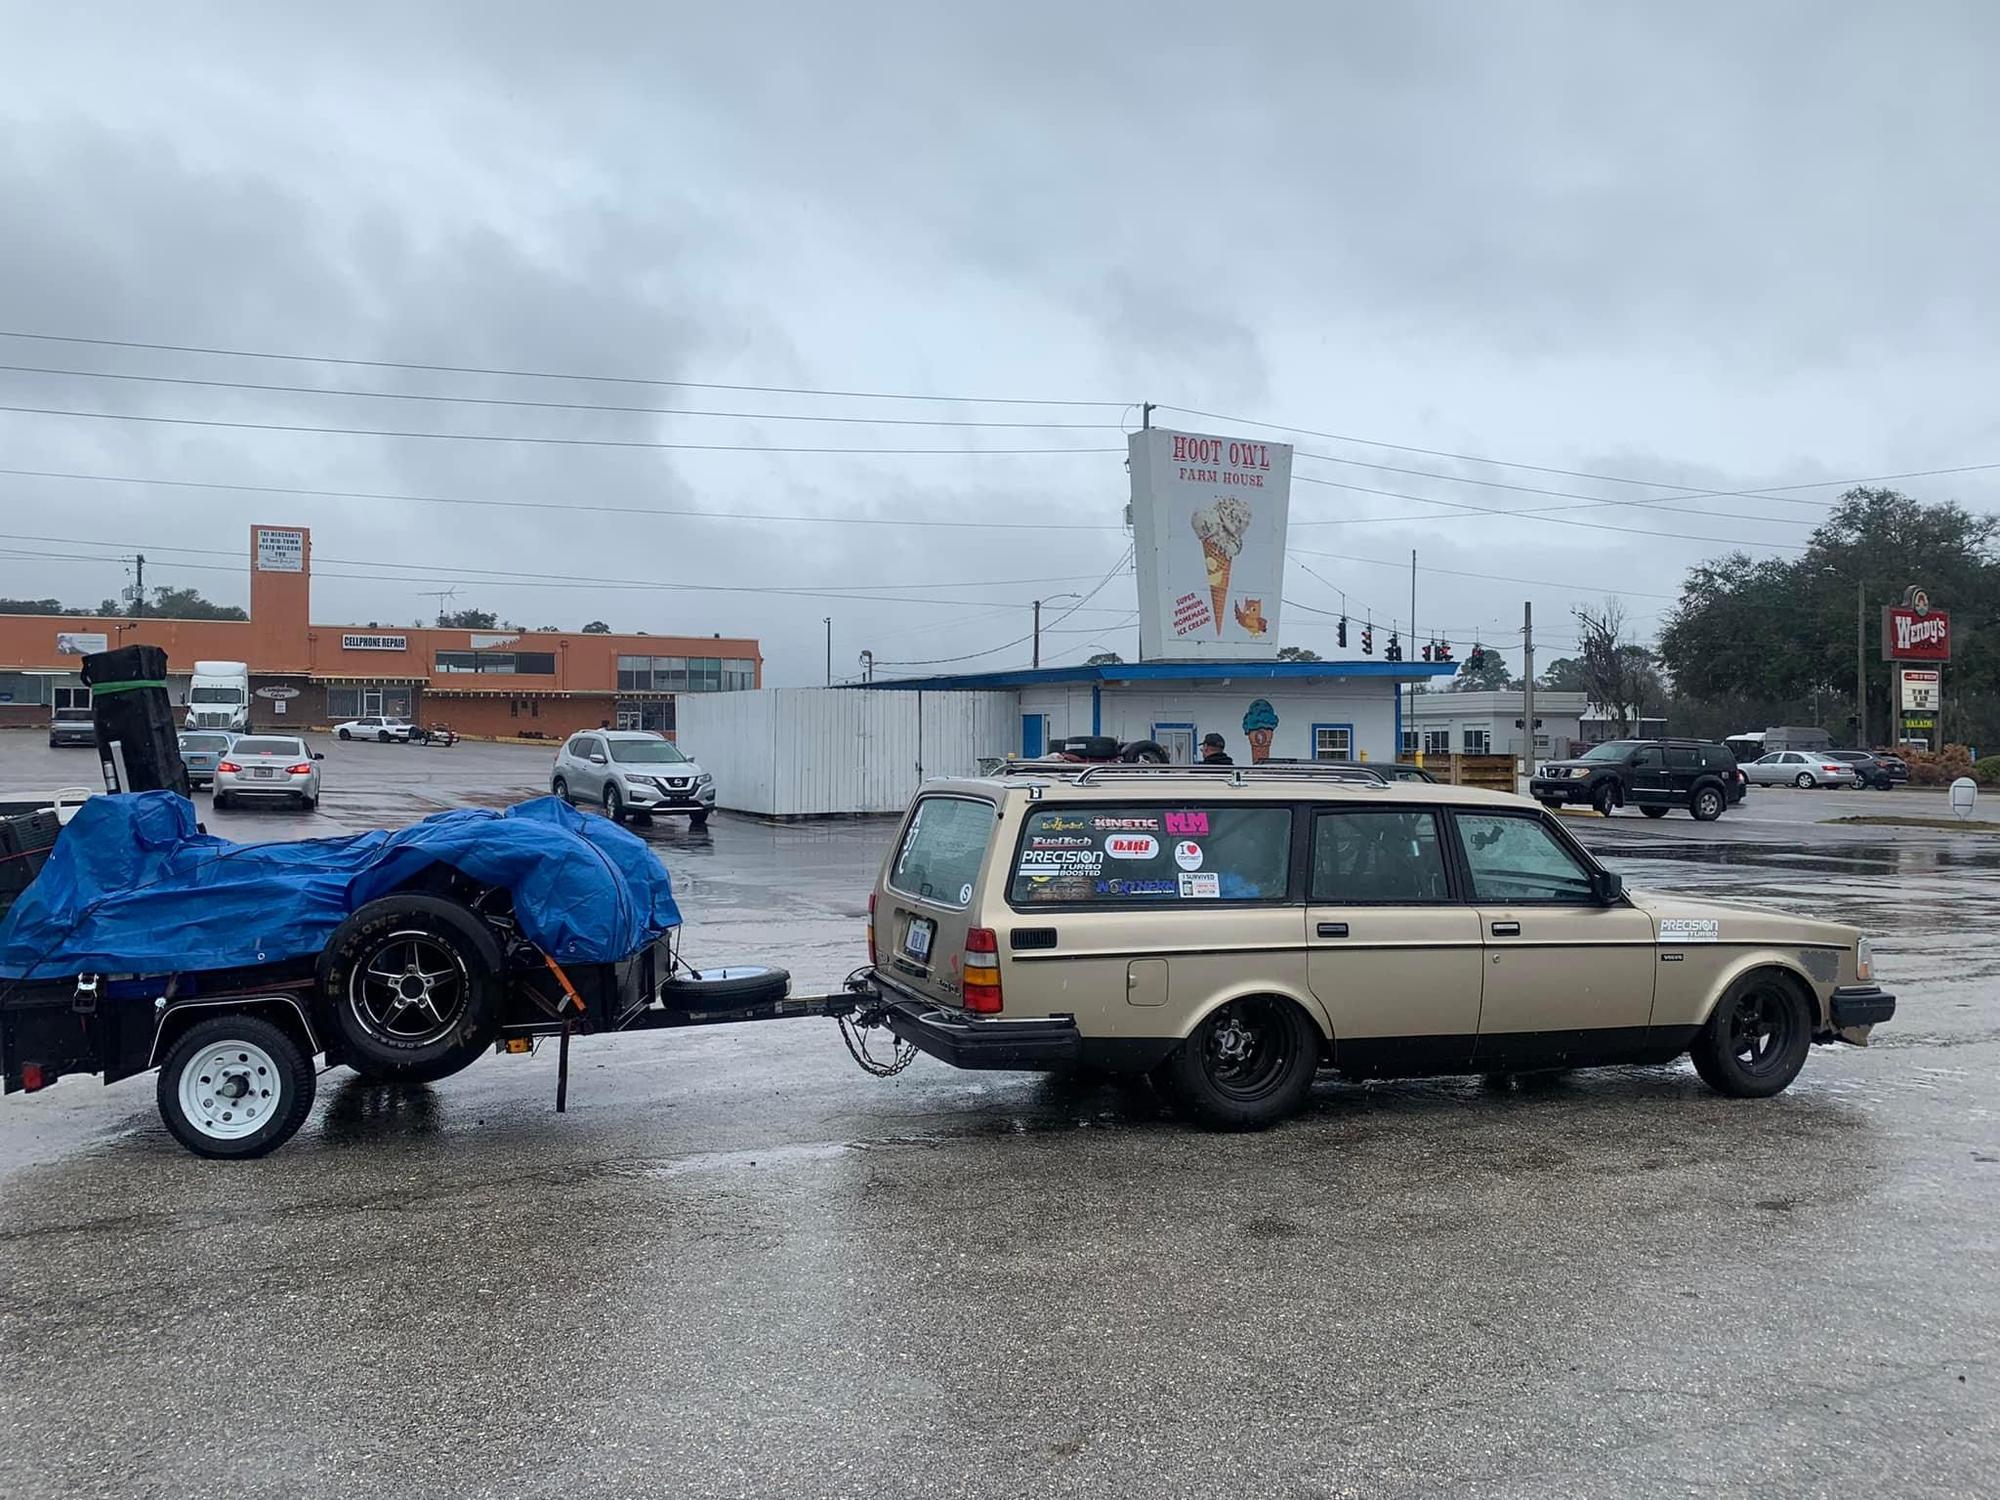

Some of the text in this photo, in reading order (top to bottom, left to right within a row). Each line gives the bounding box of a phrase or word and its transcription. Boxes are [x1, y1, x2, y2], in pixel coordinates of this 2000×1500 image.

[1173, 436, 1270, 470] HOOT OWL
[1179, 468, 1264, 487] FARM HOUSE
[1176, 592, 1196, 606] SUPER
[1174, 600, 1203, 616] PREMIUM
[1173, 606, 1209, 628] HOMEMADE
[1177, 627, 1187, 636] ICE
[344, 636, 405, 648] CELLPHONE REPAIR
[1094, 817, 1159, 828] KINETIC
[1032, 836, 1093, 847] FuelTech
